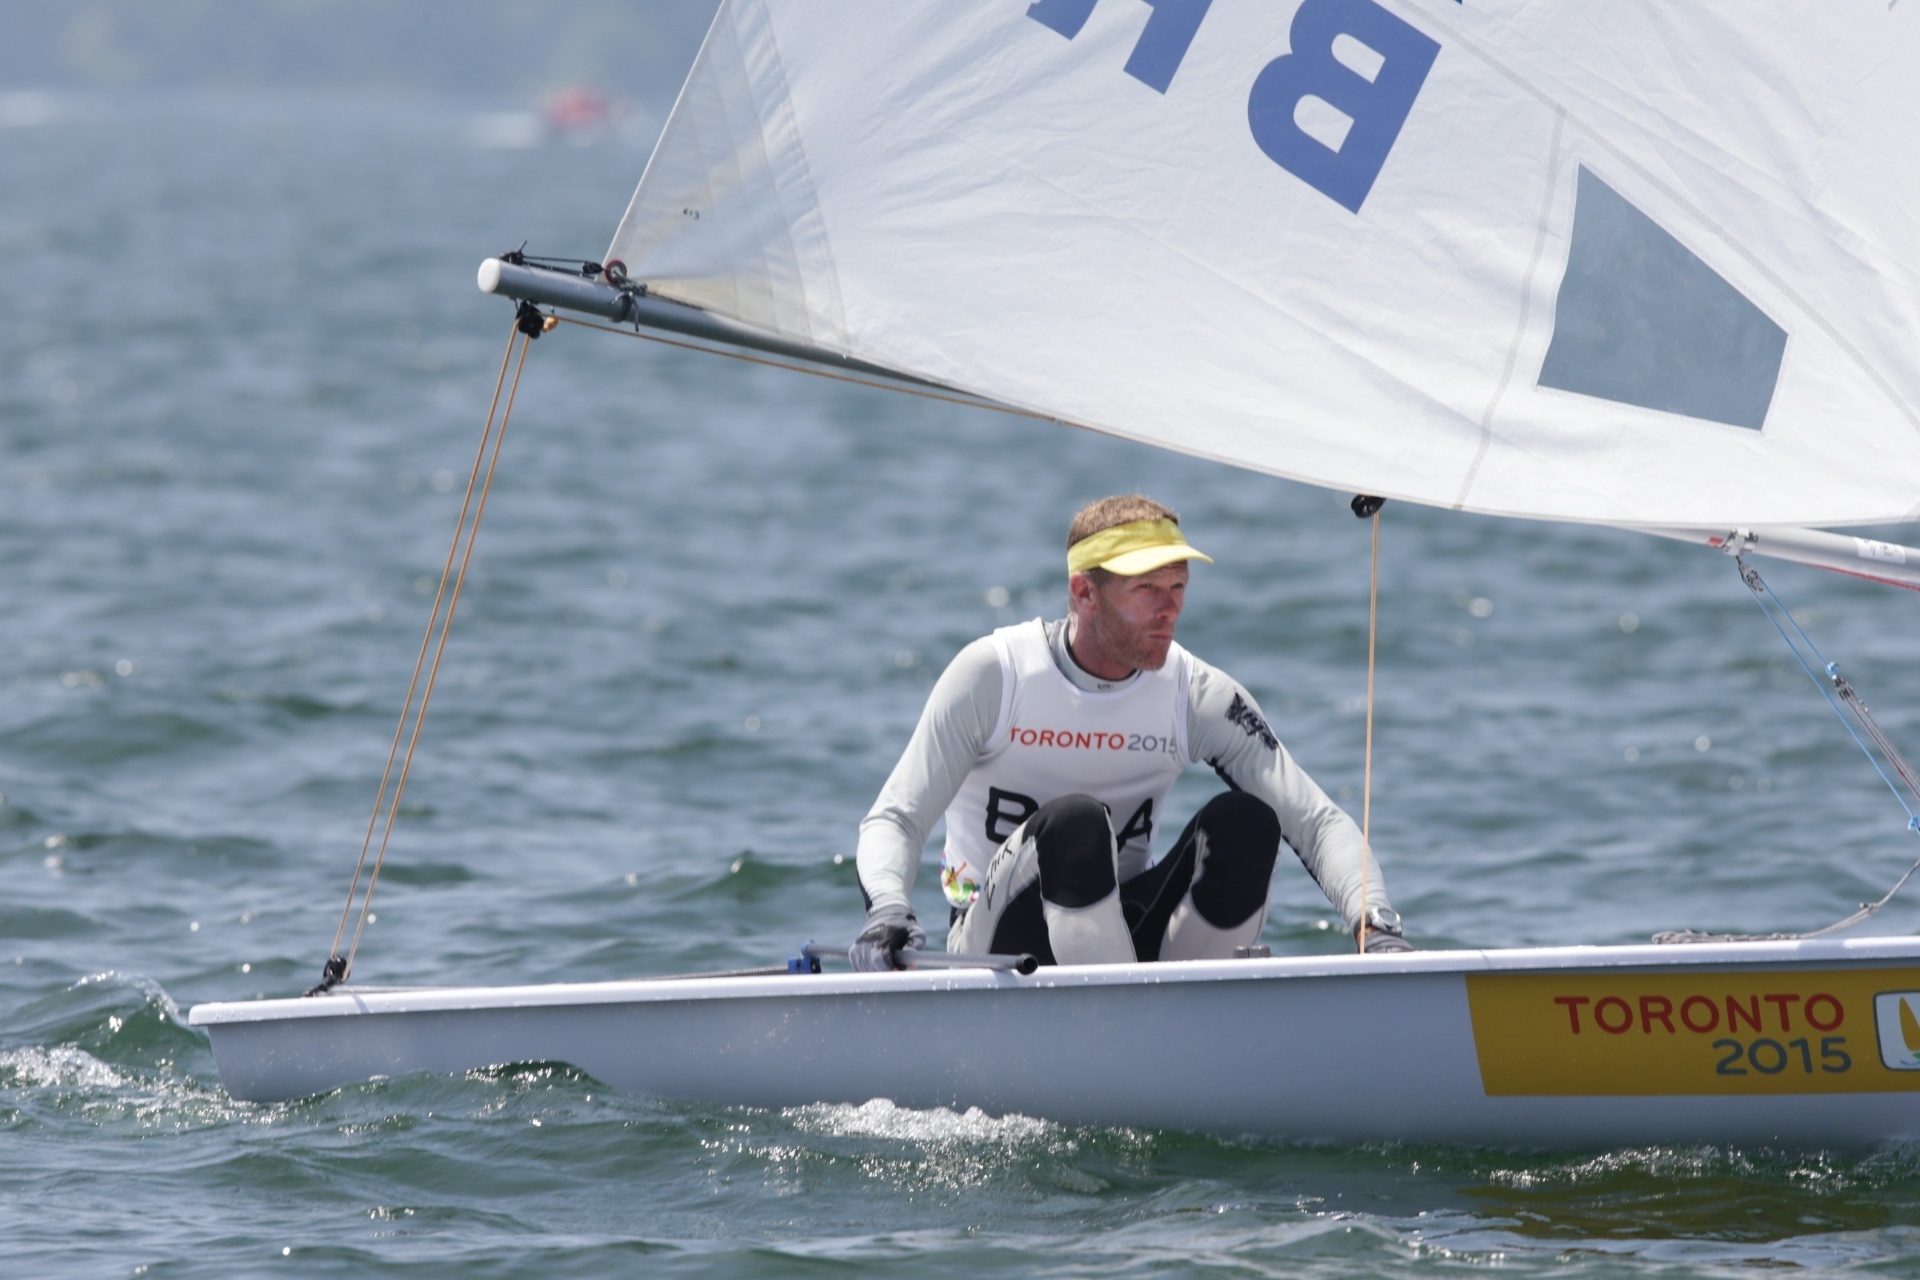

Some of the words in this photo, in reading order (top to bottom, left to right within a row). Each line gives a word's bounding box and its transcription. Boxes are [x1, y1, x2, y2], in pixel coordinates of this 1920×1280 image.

[1010, 727, 1125, 750] TORONTO
[1127, 734, 1178, 754] 2015
[985, 785, 1154, 853] BA
[1554, 994, 1845, 1035] TORONTO
[1712, 1037, 1852, 1075] 2015
